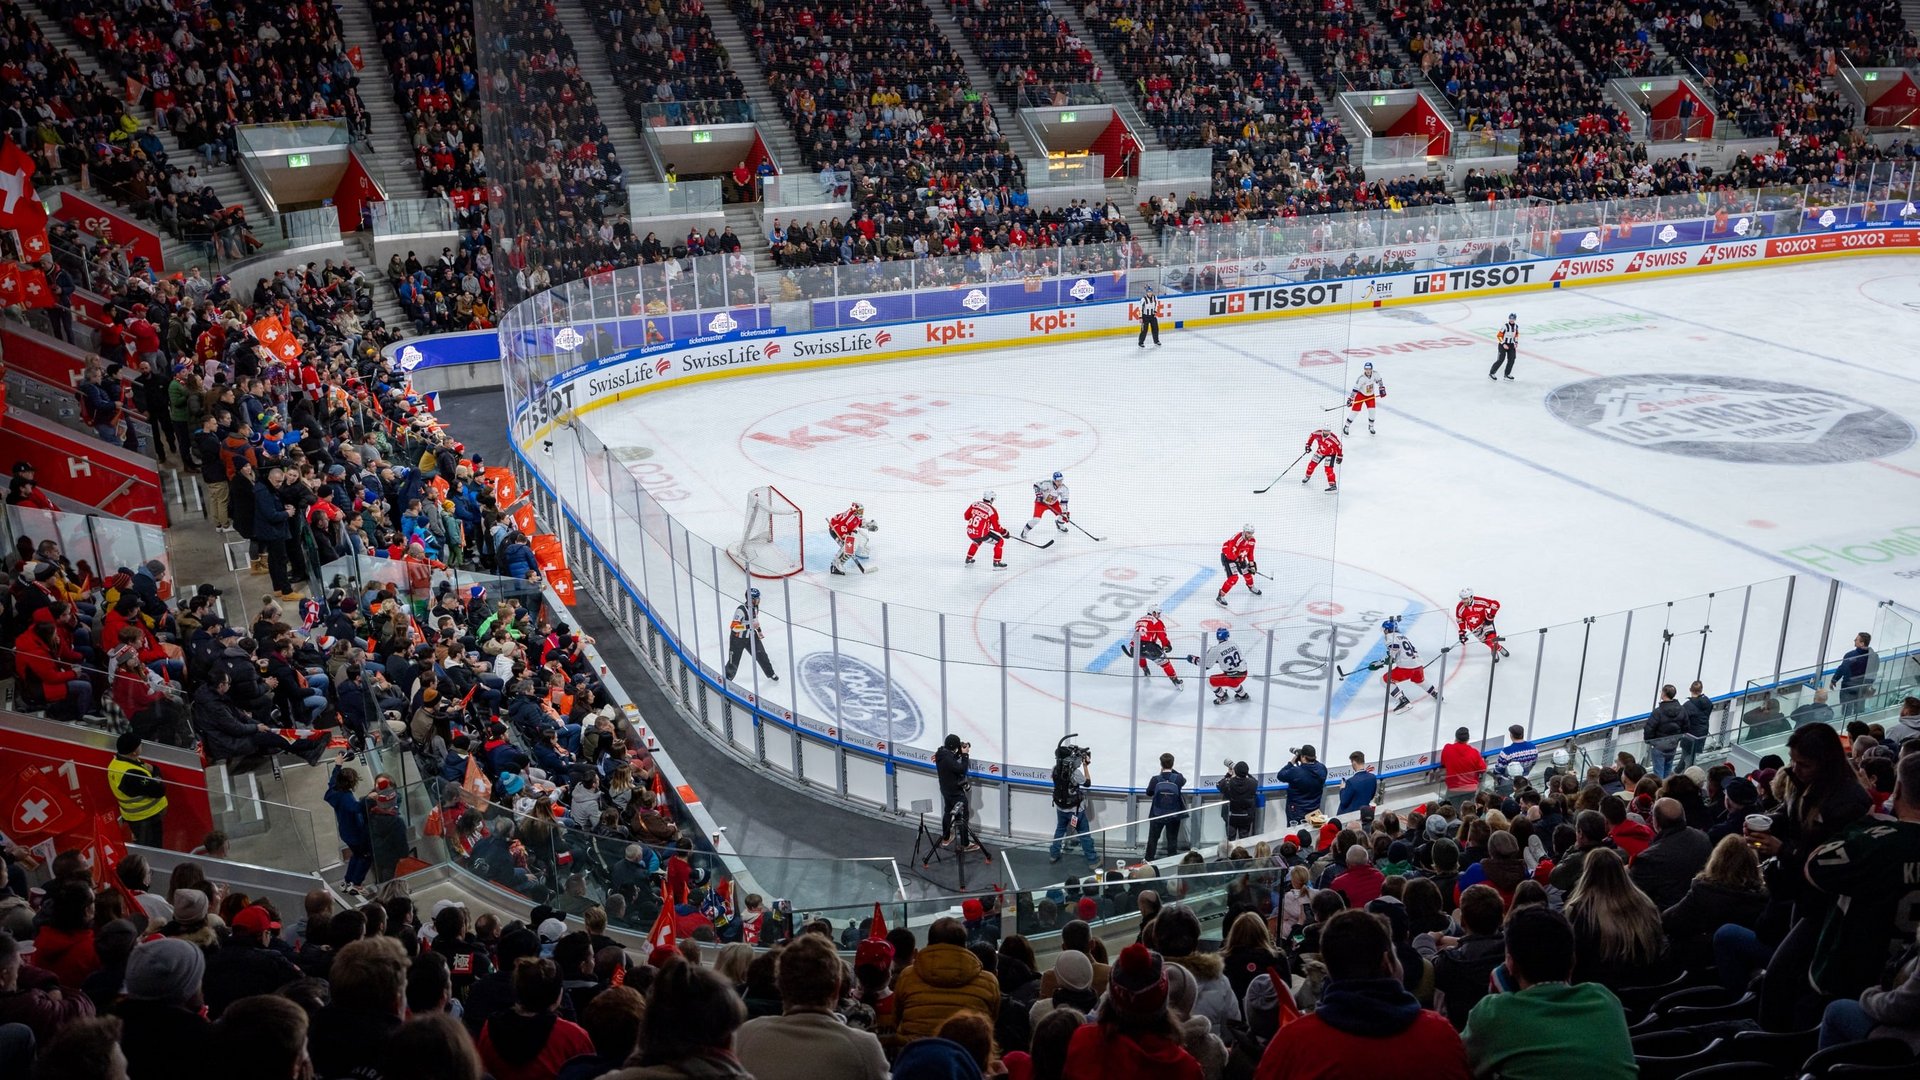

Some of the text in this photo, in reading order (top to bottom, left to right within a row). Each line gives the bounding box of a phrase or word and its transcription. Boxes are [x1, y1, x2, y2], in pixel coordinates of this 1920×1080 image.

[1425, 115, 1438, 128] F2
[1717, 146, 1726, 156] F1
[1446, 163, 1456, 176] F2
[359, 176, 369, 190] G1
[84, 216, 112, 232] G2
[1776, 238, 1817, 254] ROXOR
[1841, 232, 1886, 248] ROXOR
[1391, 248, 1416, 259] SWISS
[1645, 251, 1688, 268] SWISS
[1717, 243, 1757, 260] SWISS
[1216, 264, 1241, 276] WISS
[1571, 258, 1615, 276] SWISS
[1449, 264, 1535, 291] TISSOT
[1376, 282, 1393, 293] EHT
[1249, 283, 1343, 311] TISSOT
[71, 304, 88, 321] H
[1029, 310, 1076, 334] kpt:
[688, 334, 727, 345] ticketmaster
[740, 327, 780, 337] ticketmaster
[926, 320, 974, 345] kpt:
[640, 342, 676, 355] ticketmaster
[793, 332, 873, 357] SwissLife
[1342, 336, 1476, 358] SWISS
[597, 352, 630, 367] ticketmaster
[682, 345, 761, 372] SwissLife
[589, 362, 654, 397] SwissLife
[748, 393, 951, 451] kpt:
[1607, 415, 1697, 441] ICE
[1675, 396, 1848, 429] HOCKEY
[873, 422, 1083, 487] kpt:
[67, 455, 92, 479] H
[896, 748, 928, 762] SwissLife
[1385, 757, 1416, 771] SwissLife
[1011, 769, 1047, 780] SwissLife
